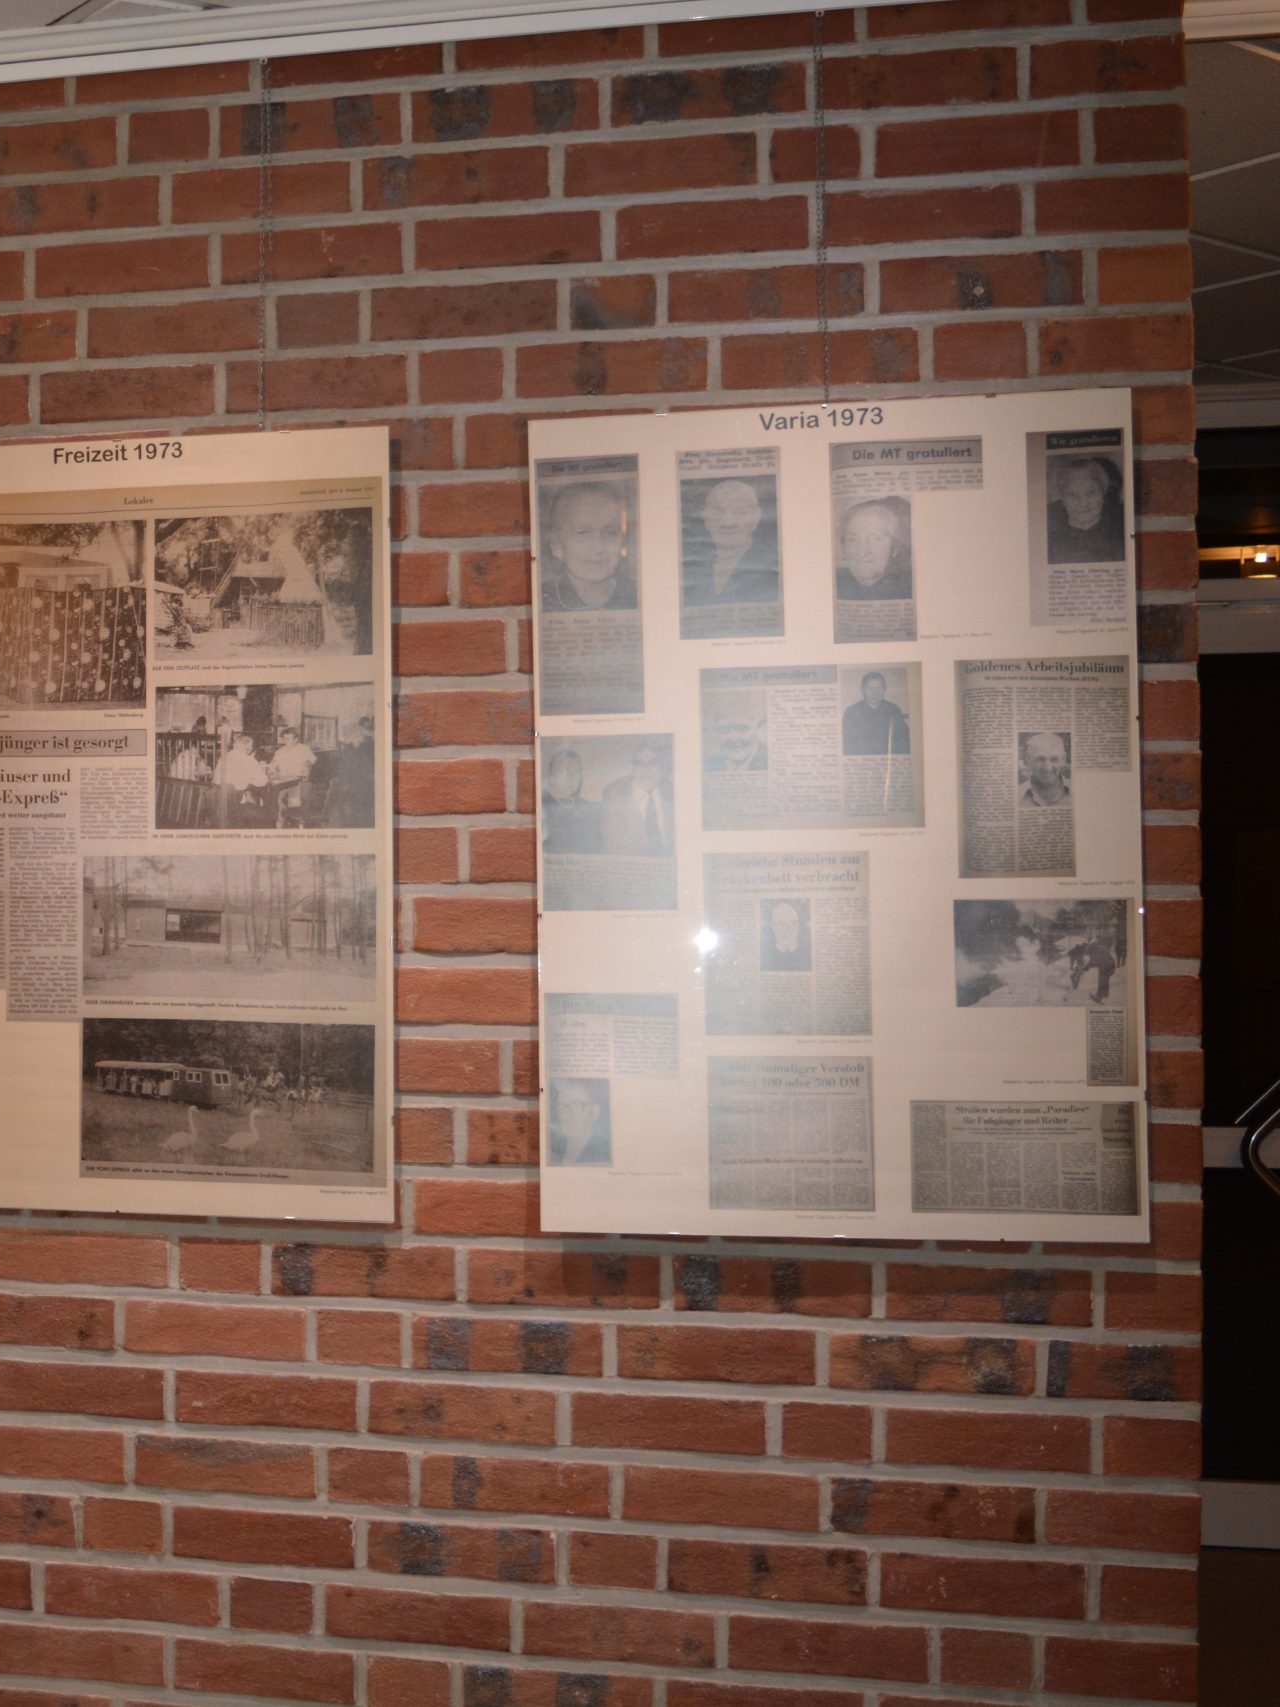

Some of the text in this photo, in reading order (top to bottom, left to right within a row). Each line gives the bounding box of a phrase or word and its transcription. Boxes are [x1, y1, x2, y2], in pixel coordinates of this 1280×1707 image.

[759, 407, 884, 431] Varia 1973
[53, 442, 183, 464] Freizeit 1973
[852, 446, 972, 461] Die MT gratuliert
[123, 496, 154, 505] Lokales
[964, 661, 1124, 675] Goldenes Arbeitsjubiläum
[52, 735, 70, 749] ist
[73, 735, 129, 754] gesorgt
[42, 768, 71, 783] und
[31, 812, 67, 821] ausgebaut
[782, 853, 837, 866] Stunden
[839, 856, 861, 865] am
[795, 869, 861, 882] verbracht
[820, 1063, 865, 1074] Verstoß
[785, 1077, 812, 1088] oder
[839, 1077, 860, 1088] DM
[990, 1106, 1021, 1114] wurden
[963, 1117, 976, 1125] für
[1024, 1117, 1040, 1125] und
